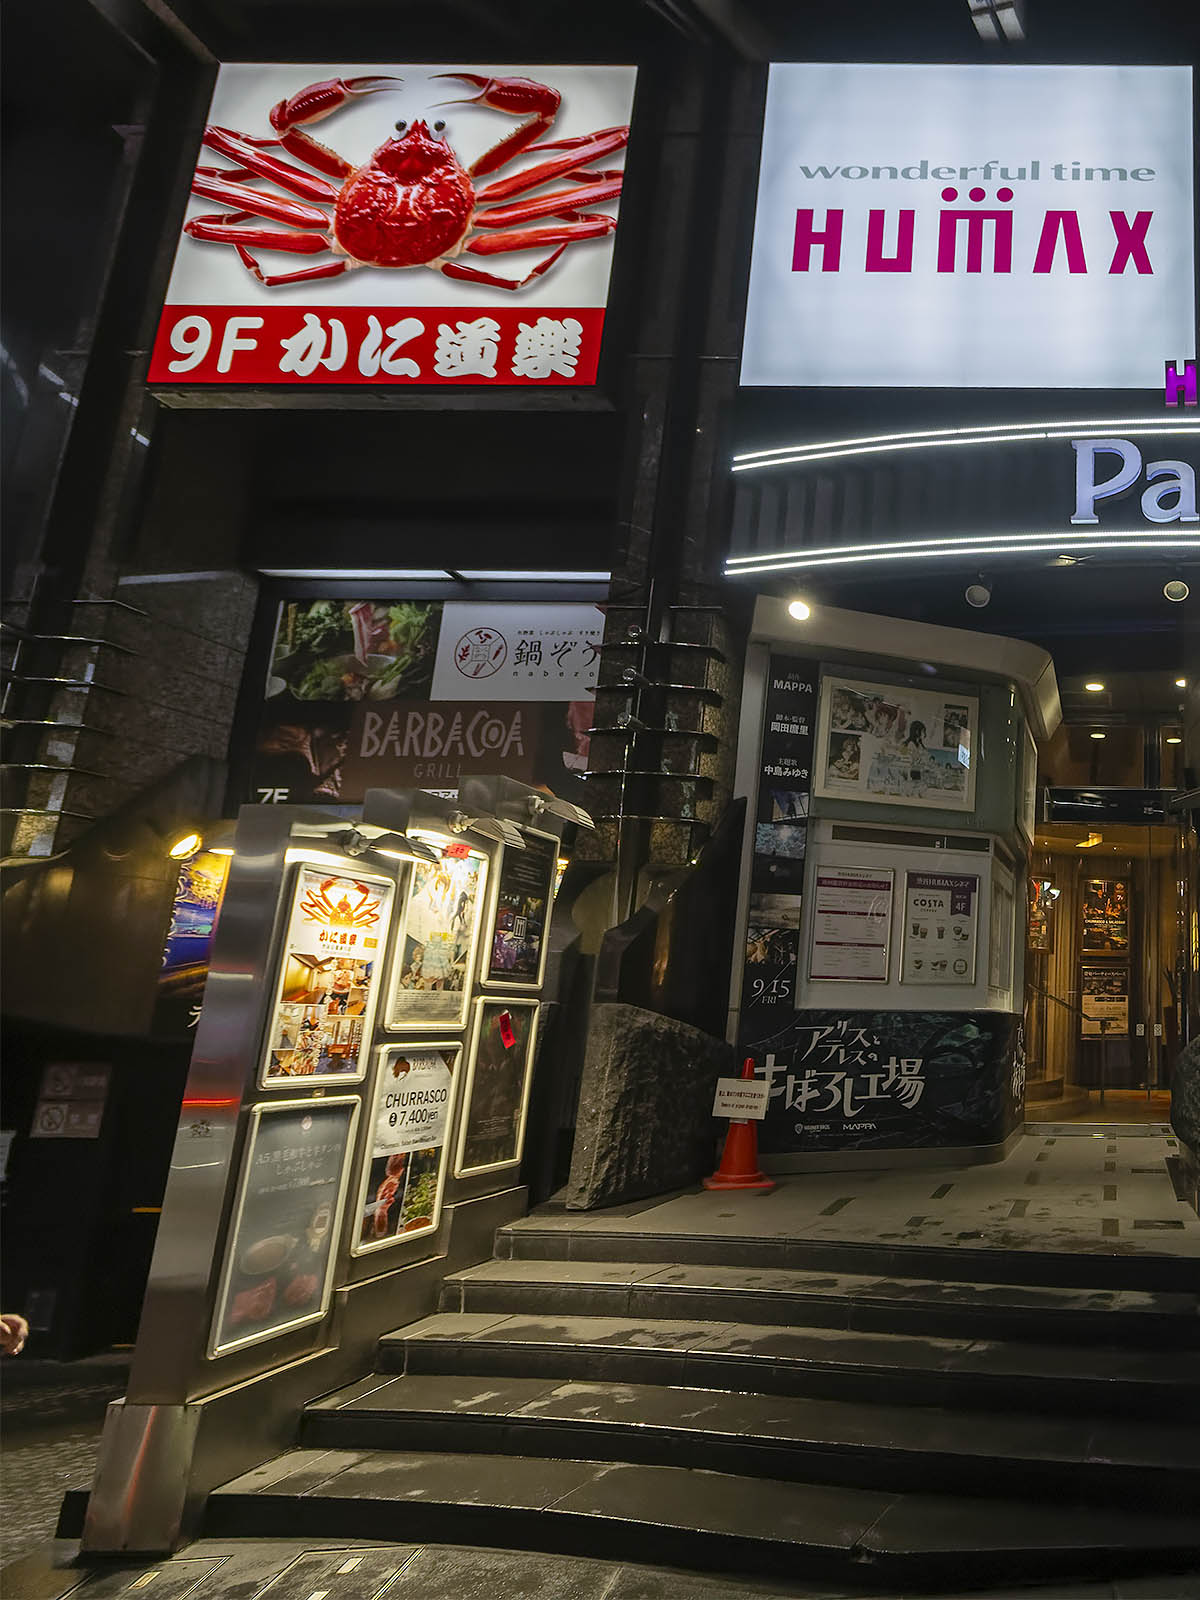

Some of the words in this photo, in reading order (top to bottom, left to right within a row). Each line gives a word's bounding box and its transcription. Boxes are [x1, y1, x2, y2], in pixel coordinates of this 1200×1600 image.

[798, 160, 1039, 181] wonderful
[1050, 162, 1156, 182] time
[167, 315, 265, 374] 9F
[278, 312, 584, 378] かに道楽
[513, 639, 598, 668] 鍋ぞう
[772, 679, 813, 694] MAPPA
[359, 710, 525, 758] BARBACOA
[763, 764, 810, 780] 中島みゆき
[912, 898, 944, 909] COSTA
[385, 1088, 448, 1109] CHURRASCO
